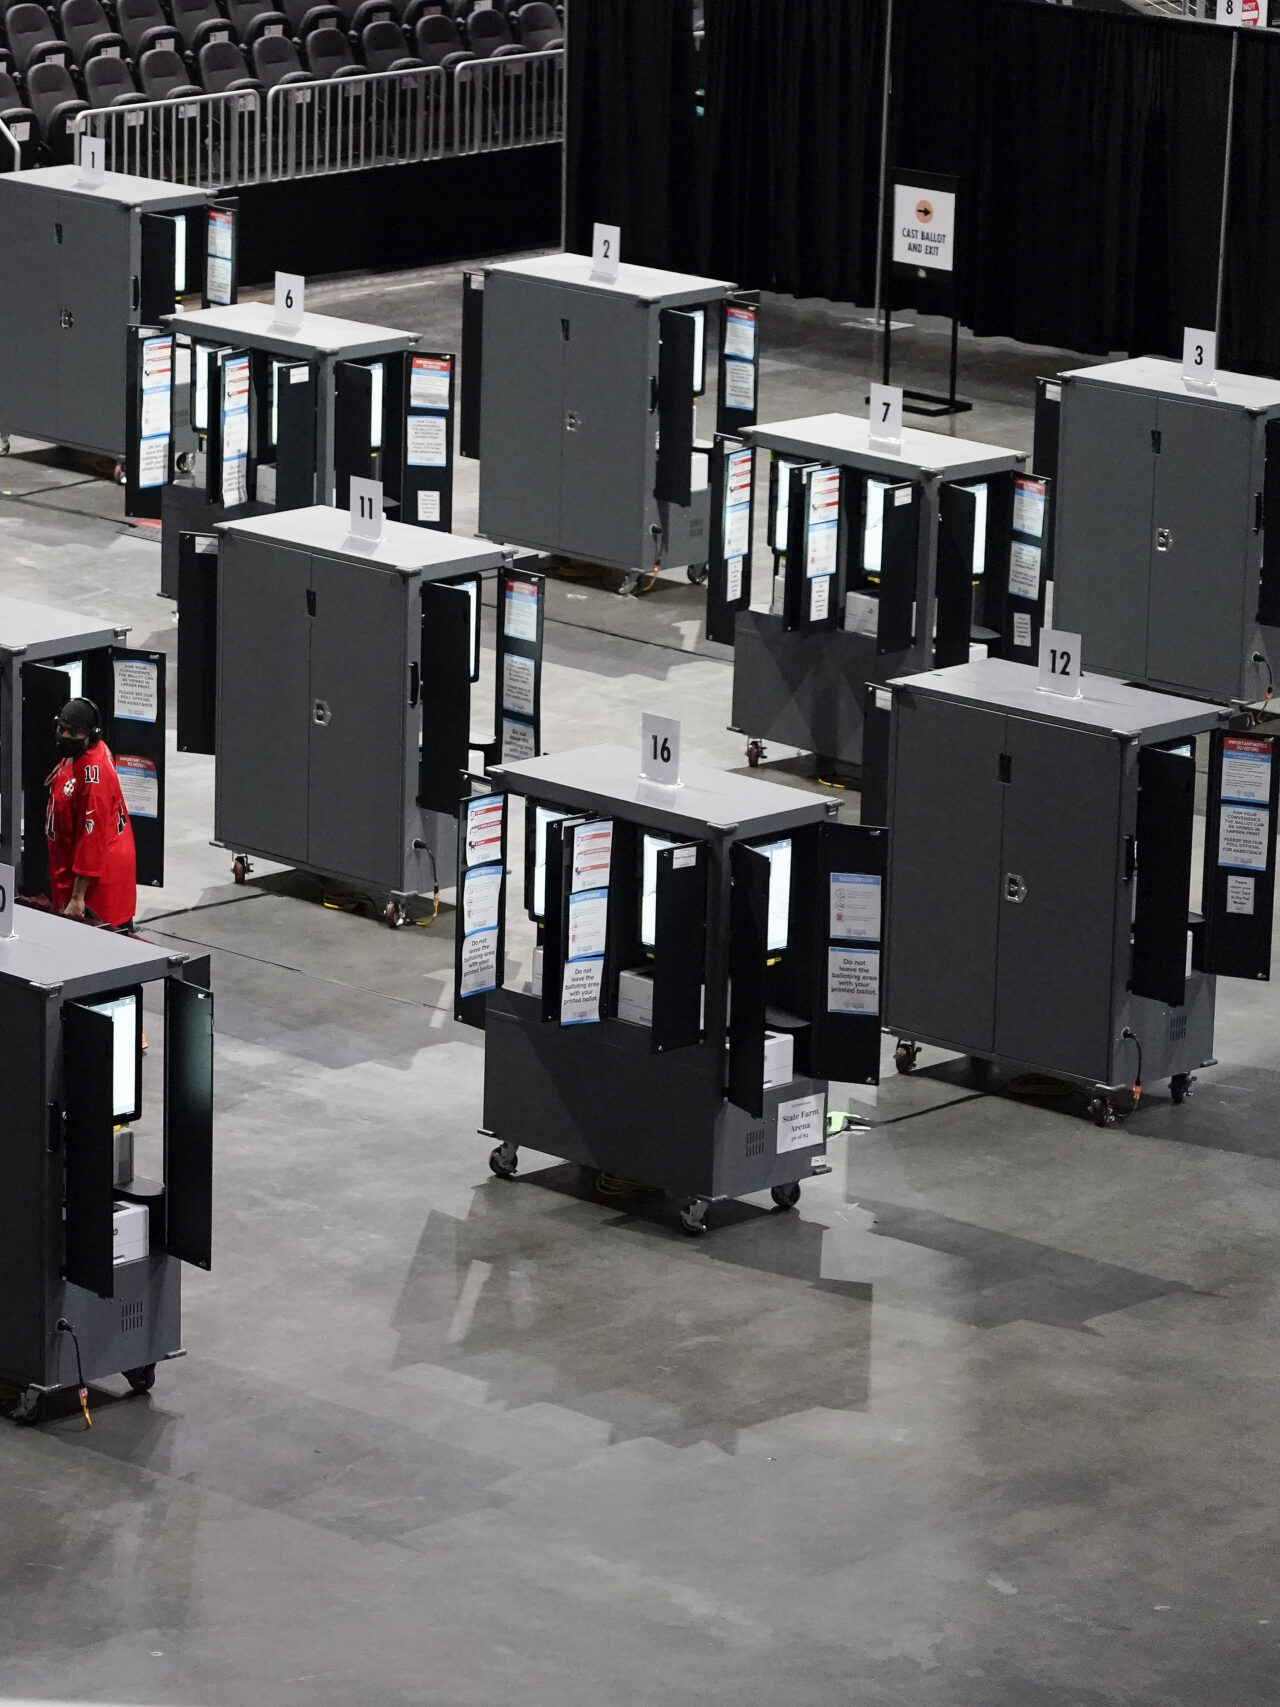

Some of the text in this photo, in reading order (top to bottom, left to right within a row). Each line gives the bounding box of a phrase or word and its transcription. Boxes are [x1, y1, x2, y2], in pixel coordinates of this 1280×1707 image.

[1226, 0, 1233, 14] 8
[91, 151, 95, 168] 1
[902, 228, 946, 244] CAST BALLOT
[603, 239, 610, 259] 2
[907, 242, 940, 256] AND EXIT
[285, 289, 293, 309] 6
[1194, 345, 1203, 366] 3
[882, 402, 891, 422] 7
[359, 495, 372, 520] 11
[1050, 649, 1071, 676] 12
[651, 735, 671, 763] 16
[84, 765, 100, 783] 11
[831, 972, 860, 981] balloting
[564, 983, 587, 991] balloting
[563, 998, 582, 1007] printed
[782, 1109, 819, 1123] State Farm
[791, 1123, 810, 1132] Arena
